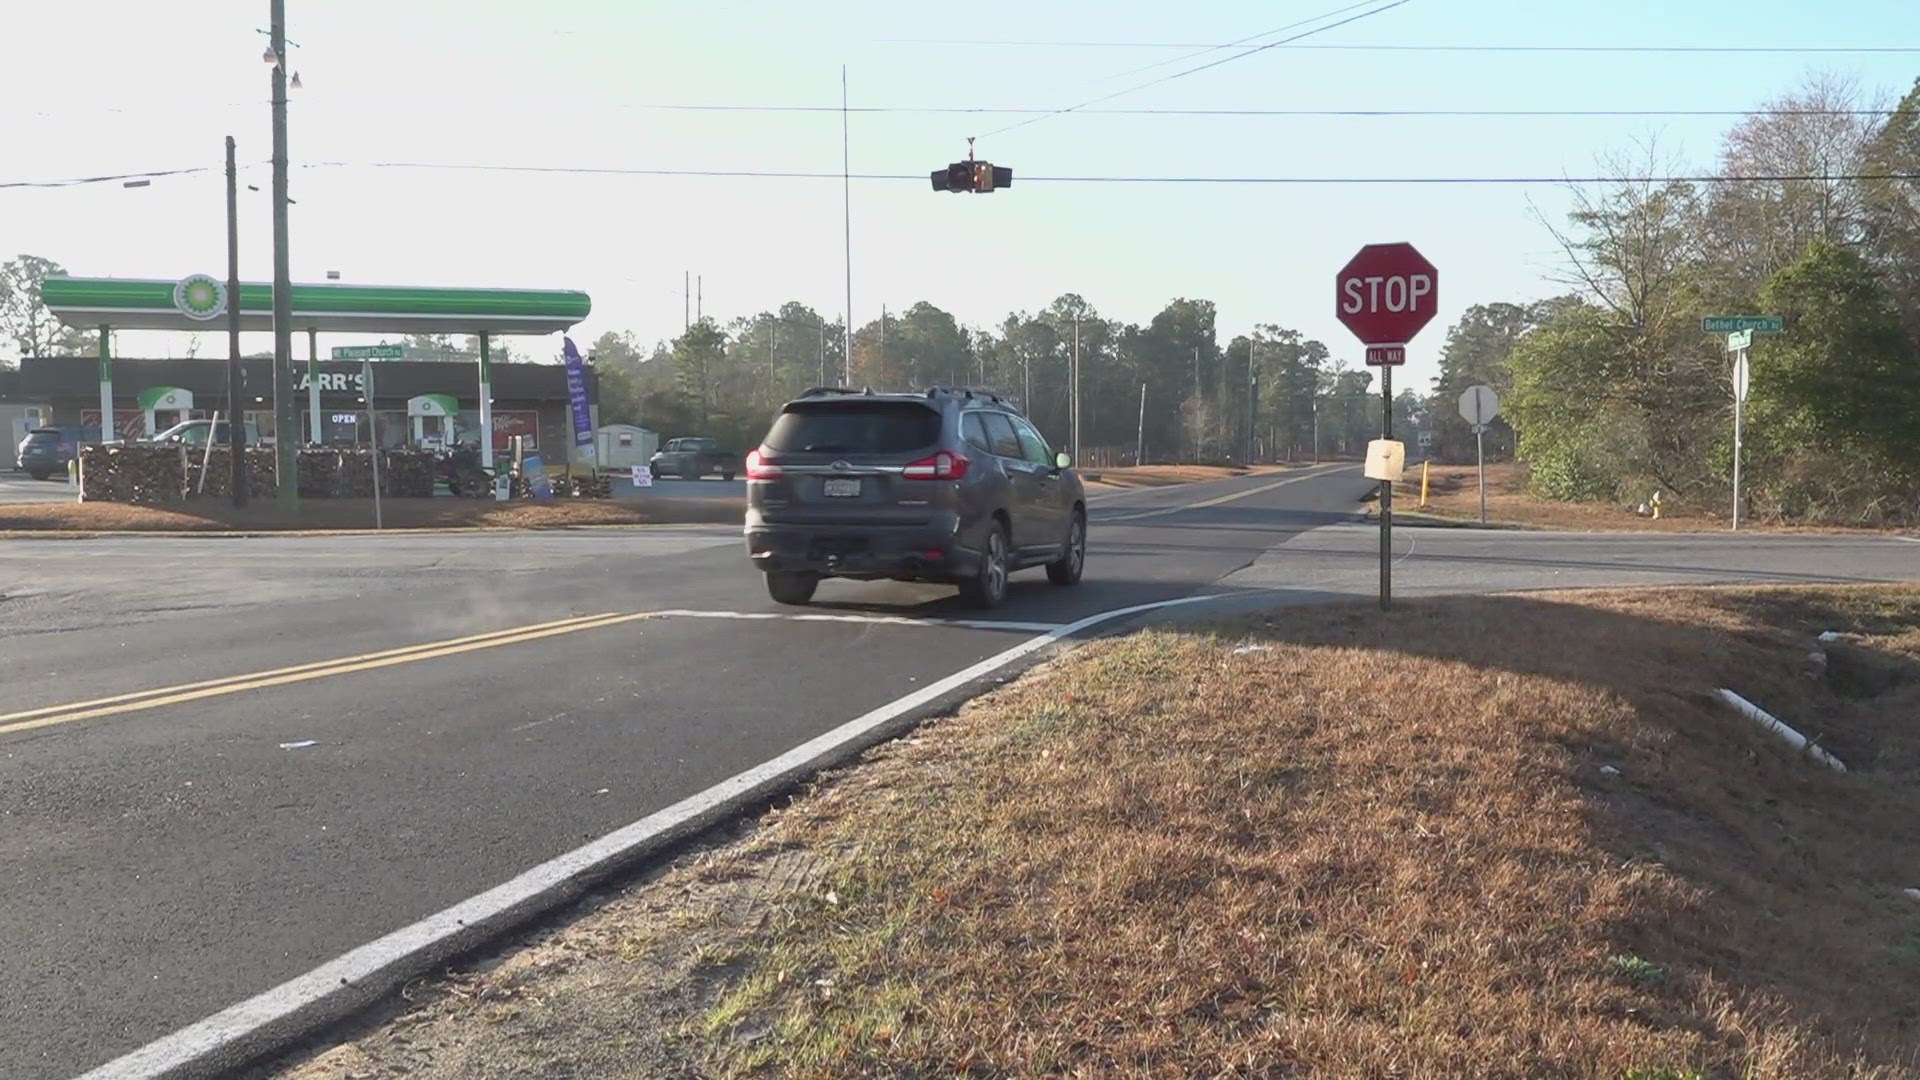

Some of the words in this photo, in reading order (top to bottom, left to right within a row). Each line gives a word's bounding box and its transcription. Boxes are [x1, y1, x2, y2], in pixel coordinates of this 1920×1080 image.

[1343, 275, 1431, 314] STOP
[1705, 319, 1733, 330] Bethel
[1736, 319, 1768, 330] Church
[1369, 350, 1382, 361] ALL
[1386, 350, 1402, 361] WAY
[293, 373, 363, 390] ARR'S
[332, 414, 356, 423] OPEN
